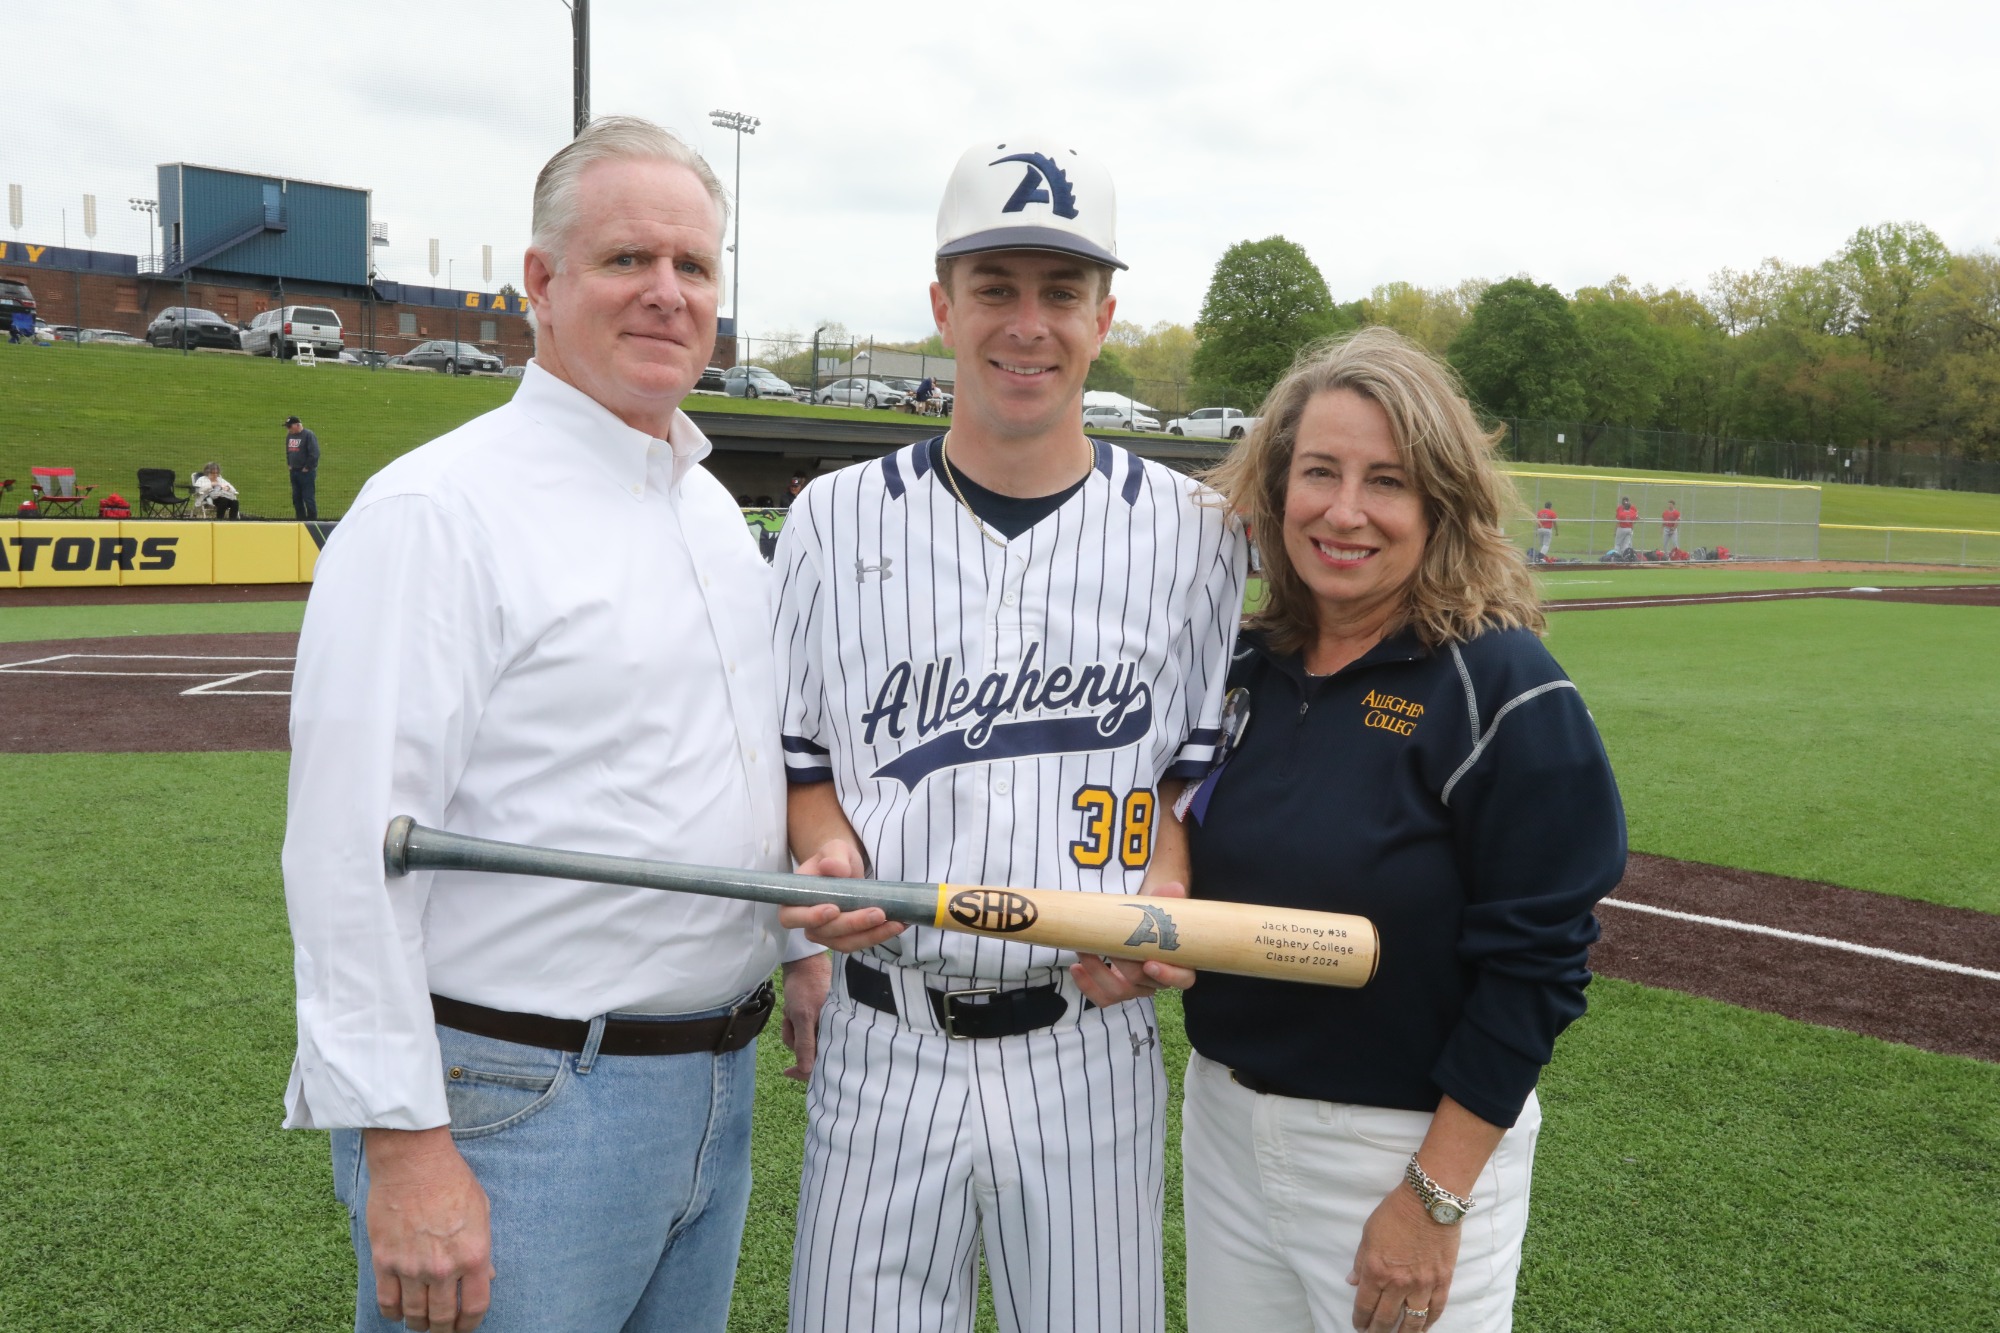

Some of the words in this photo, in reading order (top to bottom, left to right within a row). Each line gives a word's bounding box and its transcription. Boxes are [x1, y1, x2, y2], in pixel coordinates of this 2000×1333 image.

[988, 152, 1079, 220] A
[861, 641, 1140, 749] Allegheny
[1364, 710, 1418, 736] COLLEG
[1069, 784, 1156, 870] 38
[949, 889, 1038, 932] SHB
[1254, 935, 1309, 951] Allegheny
[1312, 941, 1354, 955] College
[1262, 921, 1288, 932] Jack
[1291, 924, 1325, 937] Doney
[1328, 929, 1347, 938] #38
[1266, 951, 1296, 963] Class
[1299, 955, 1310, 964] of
[1312, 956, 1339, 967] 2024
